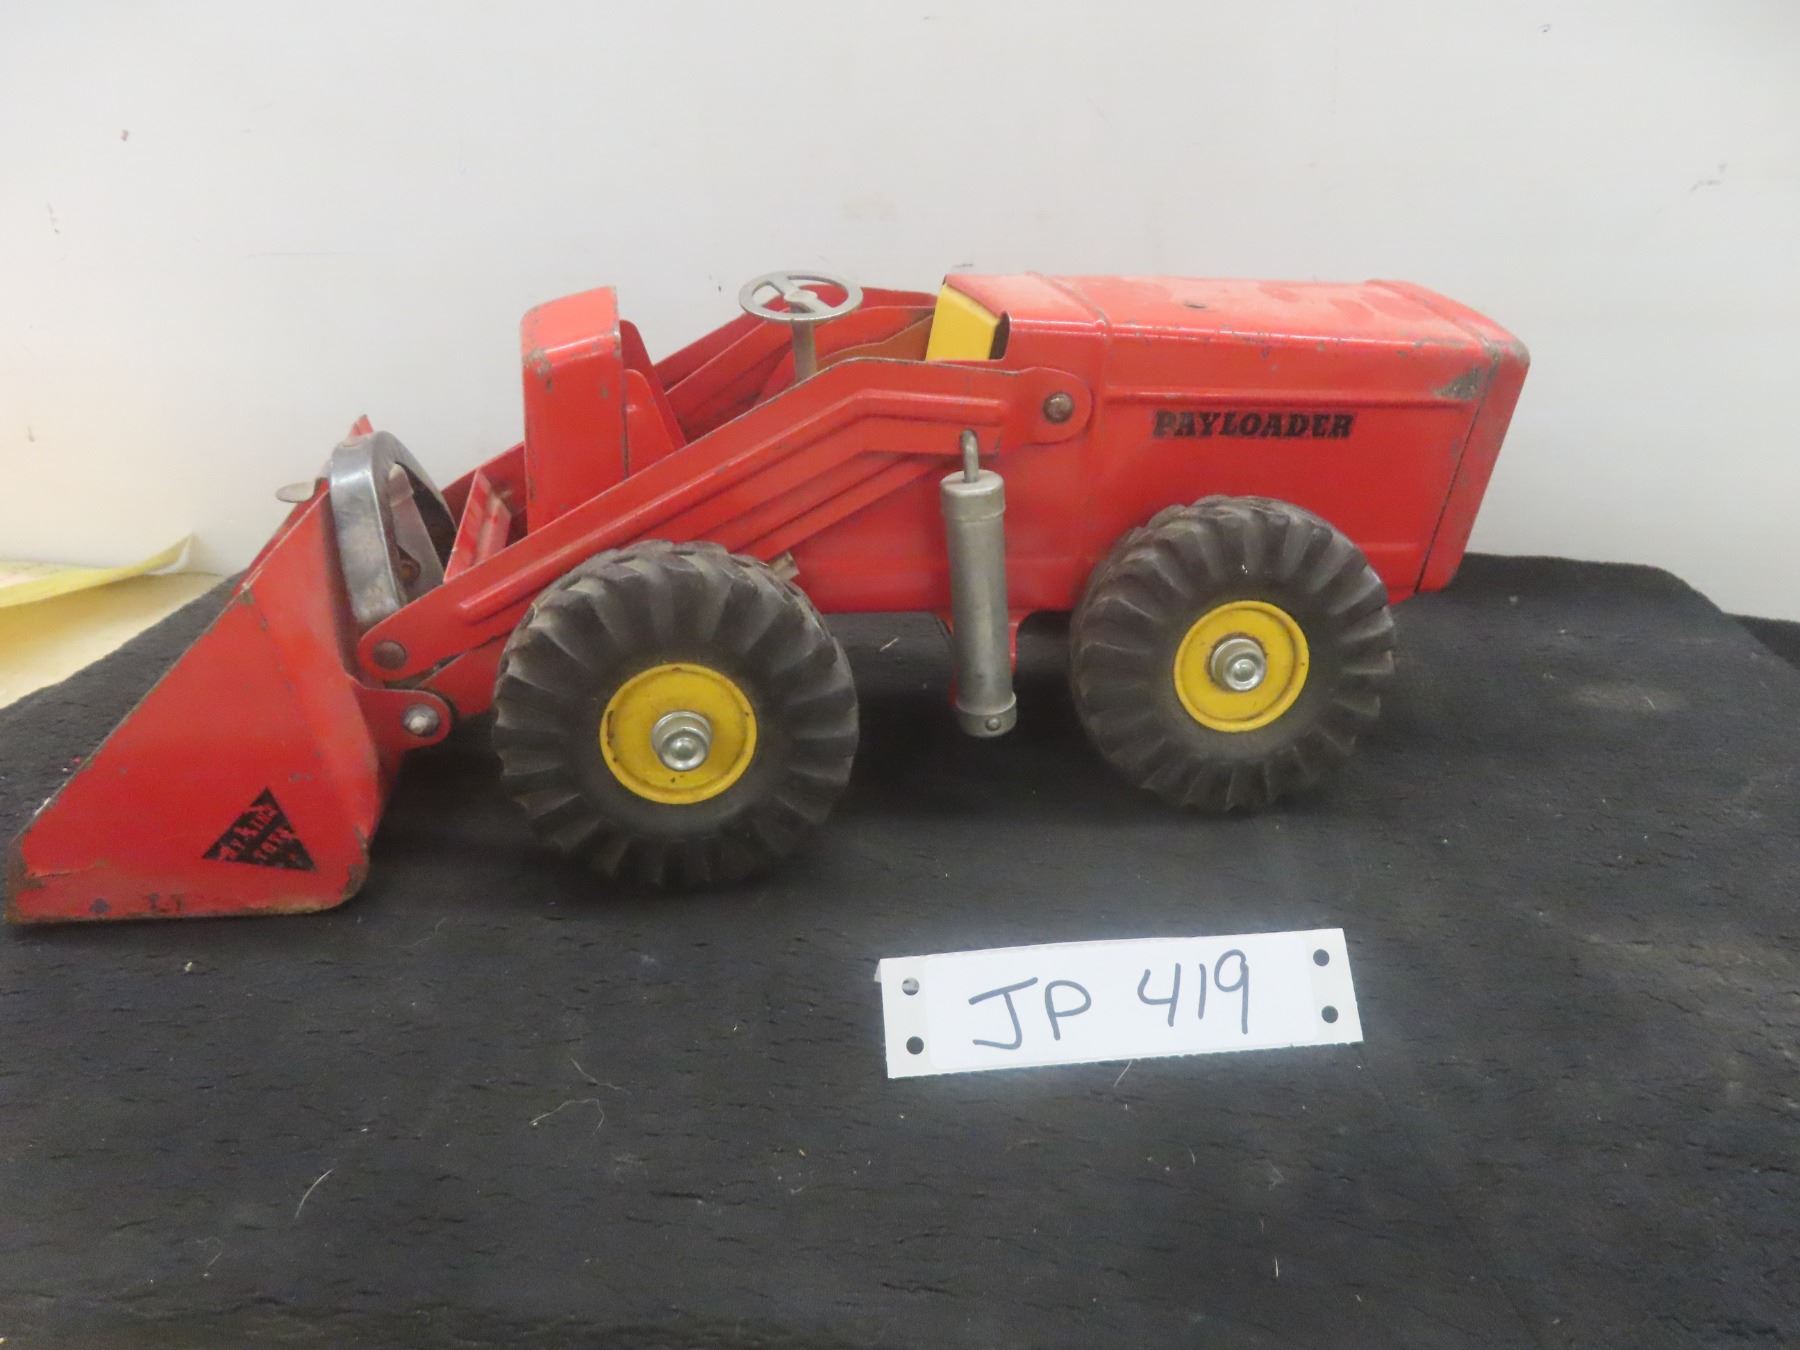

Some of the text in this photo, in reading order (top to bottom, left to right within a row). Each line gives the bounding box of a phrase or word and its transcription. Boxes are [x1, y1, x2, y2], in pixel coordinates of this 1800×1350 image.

[1153, 410, 1355, 438] PAYLOADER
[968, 949, 1249, 1050] JP 419
